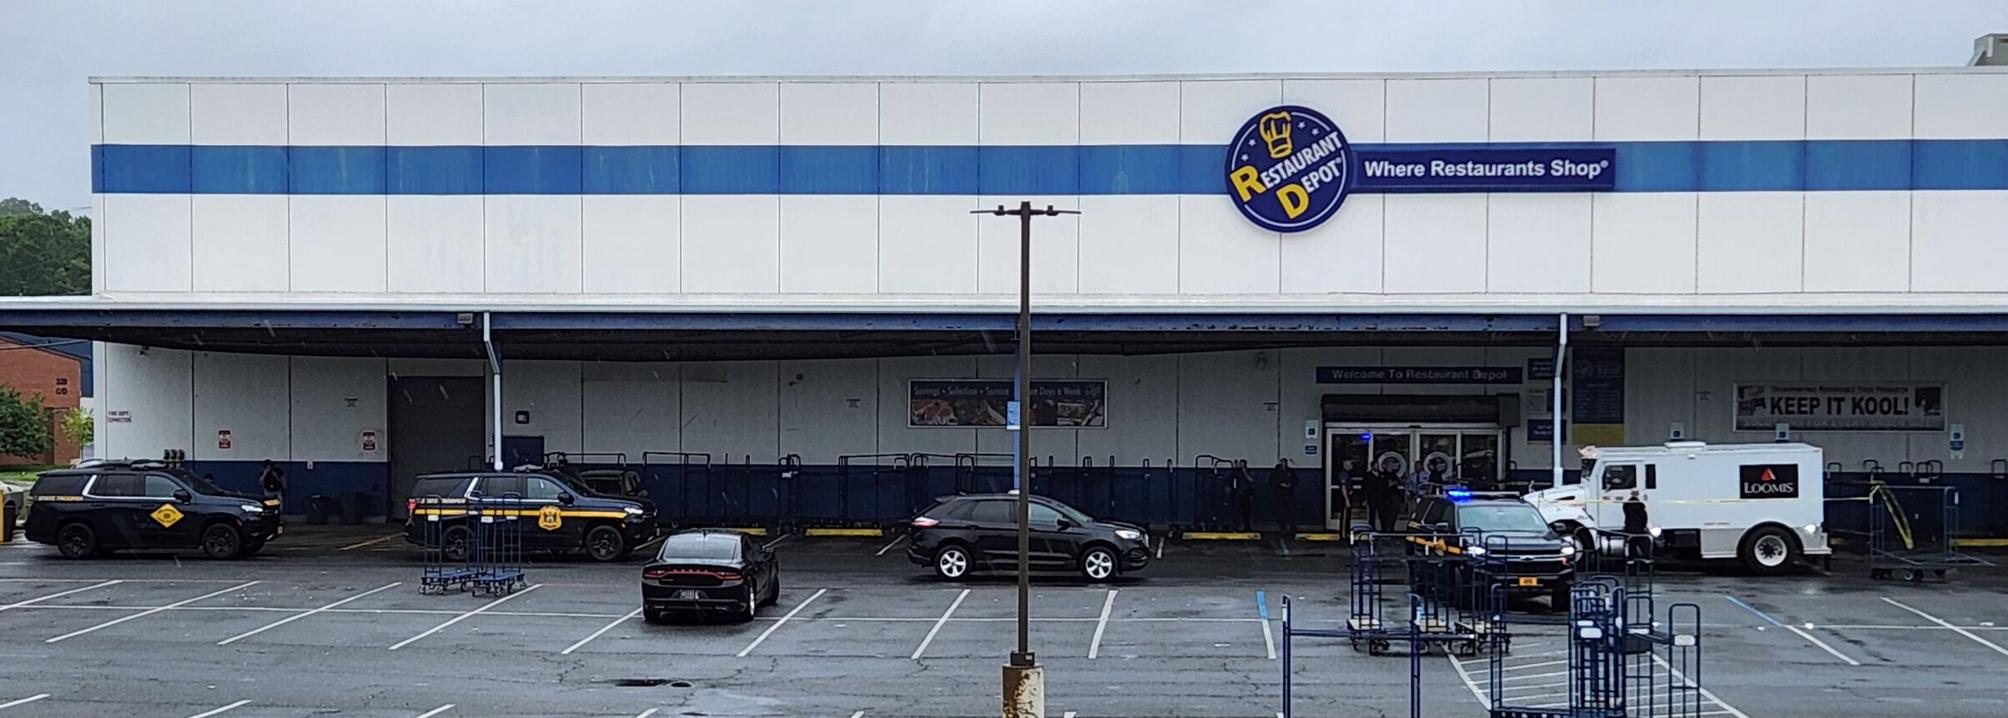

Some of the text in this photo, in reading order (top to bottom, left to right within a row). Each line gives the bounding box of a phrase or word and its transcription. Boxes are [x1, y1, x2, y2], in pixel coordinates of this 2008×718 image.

[1229, 130, 1342, 203] RESTAURANT
[1364, 160, 1426, 178] Where
[1430, 160, 1546, 178] Restaurants
[1331, 369, 1508, 381] Welcome To Restaurant Depot
[1770, 396, 1909, 415] KEEP IT KOOL!
[1743, 481, 1795, 494] LOOMIS
